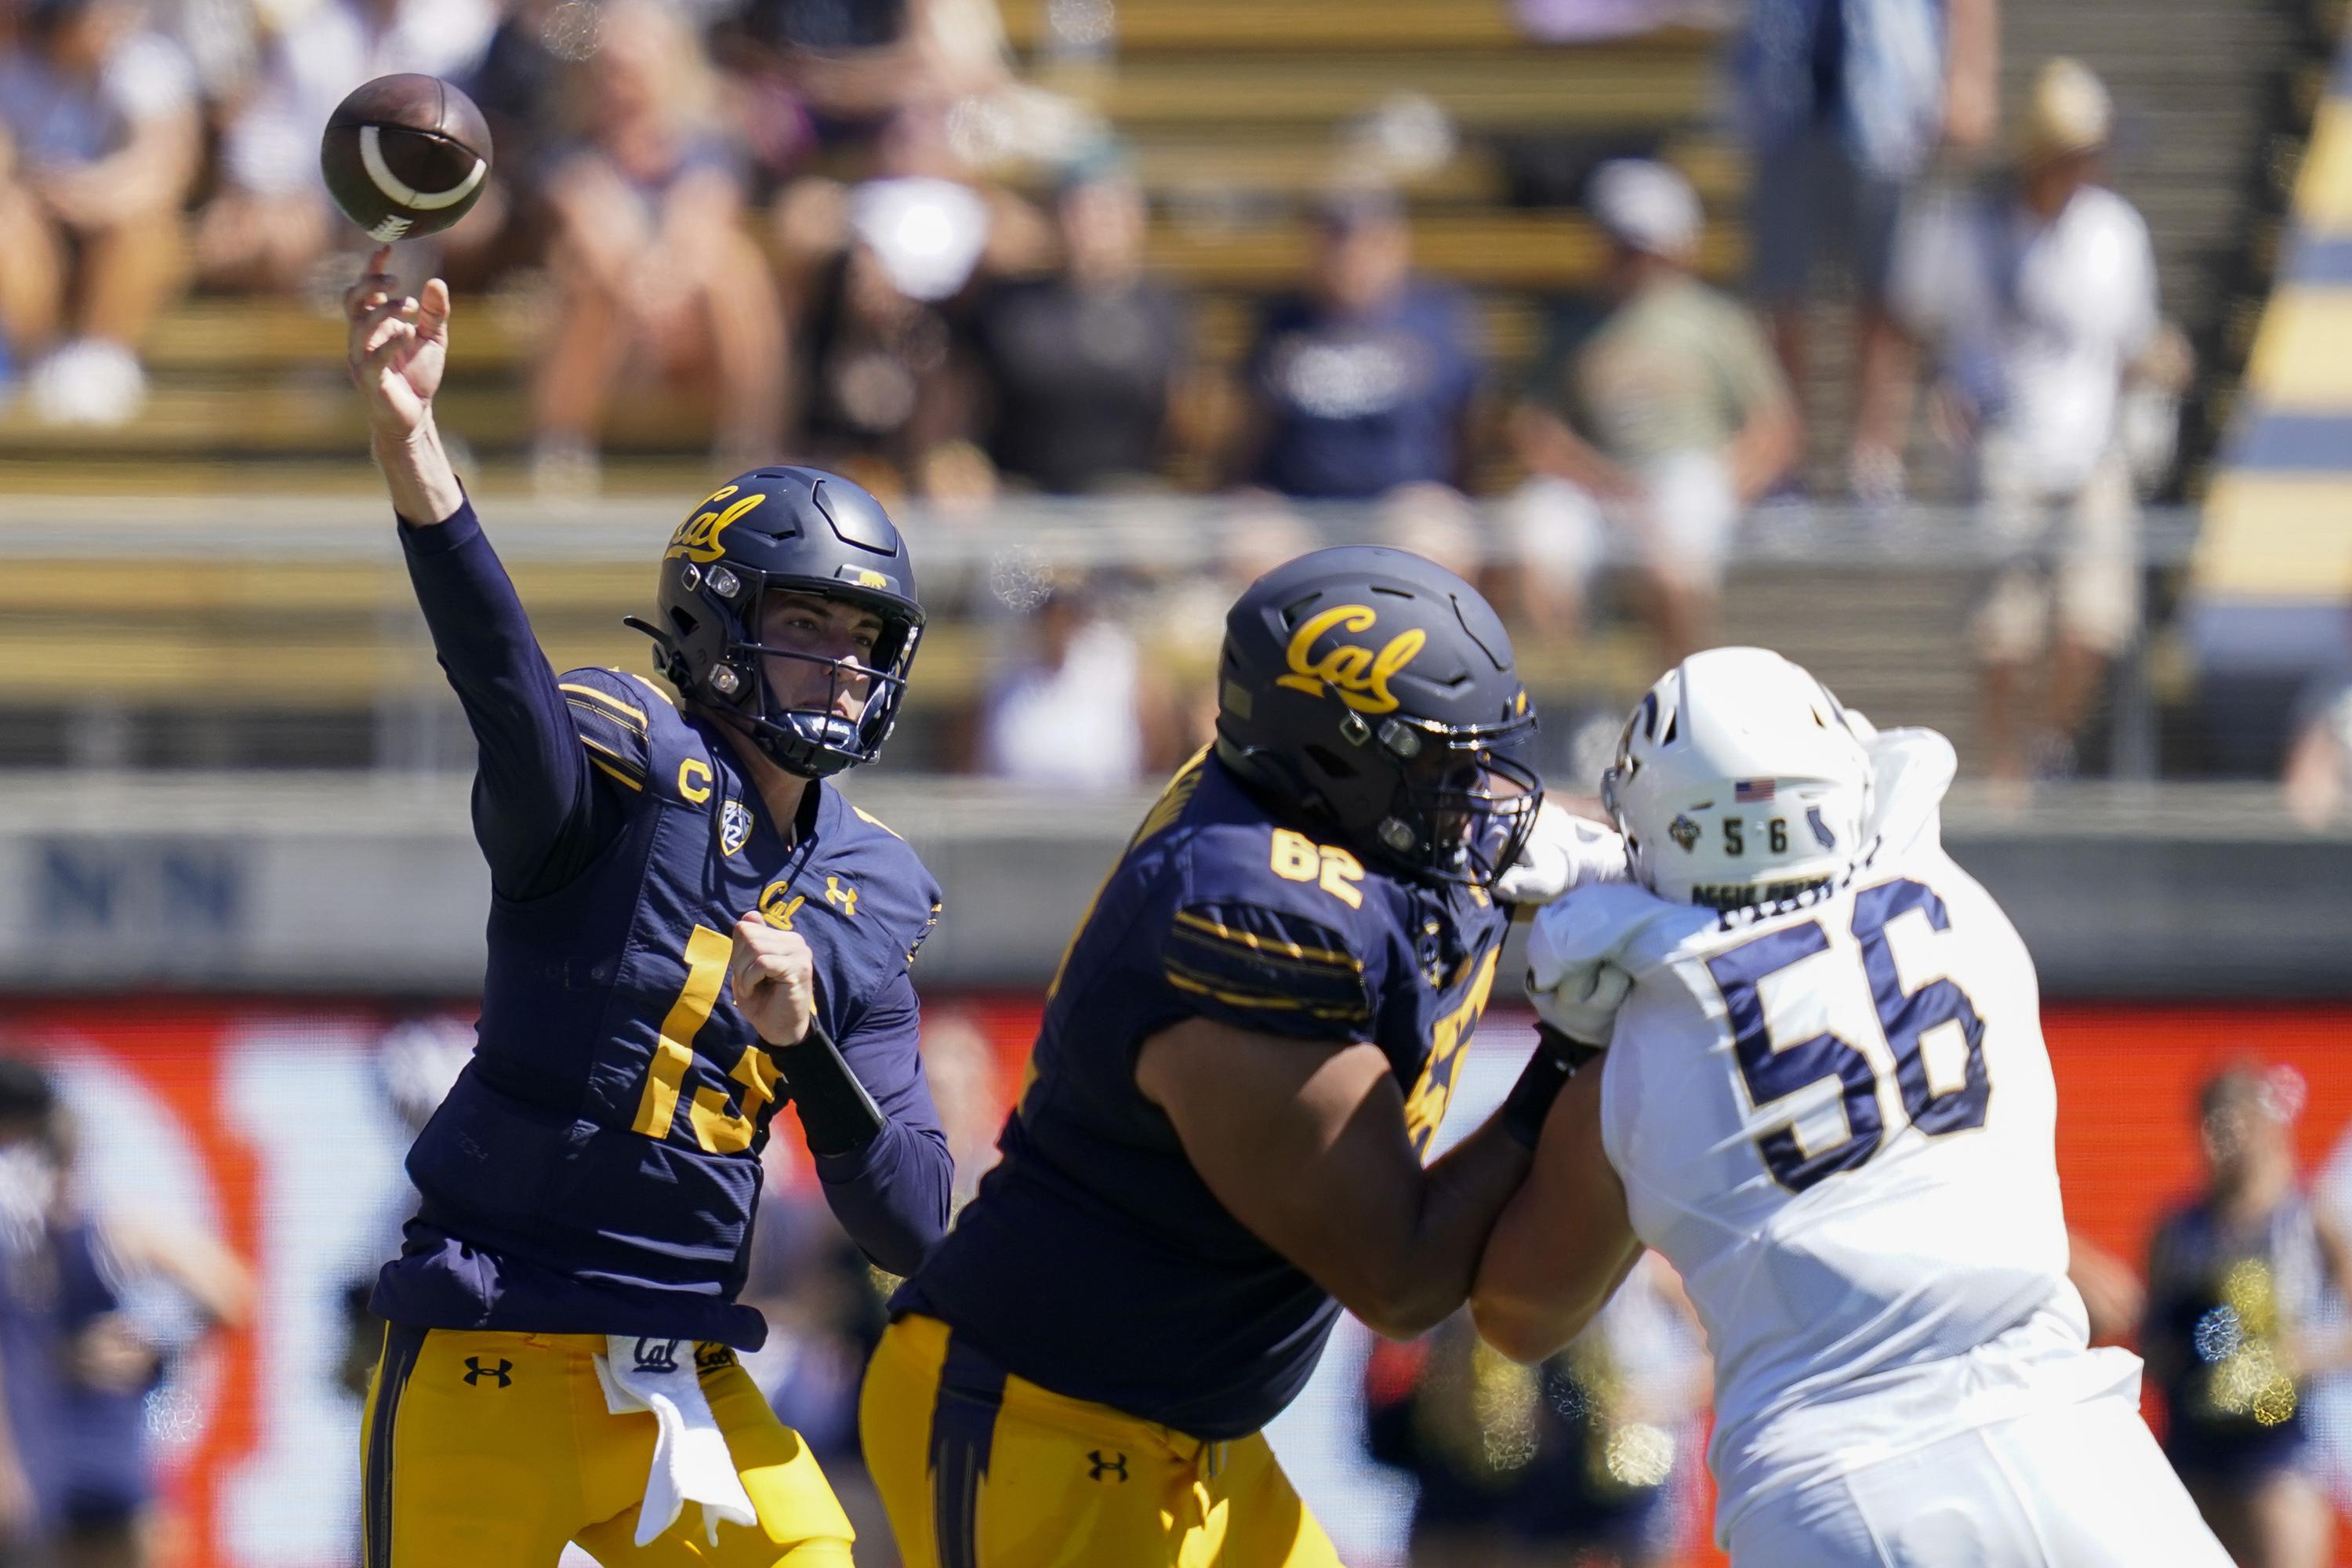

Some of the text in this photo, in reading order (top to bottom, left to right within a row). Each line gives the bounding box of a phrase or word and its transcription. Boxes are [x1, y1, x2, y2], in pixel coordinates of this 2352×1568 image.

[664, 485, 766, 563] Cal
[1276, 604, 1427, 714] Cal
[677, 757, 713, 804] C
[758, 880, 805, 931] Cal
[1704, 877, 1992, 1196] 56
